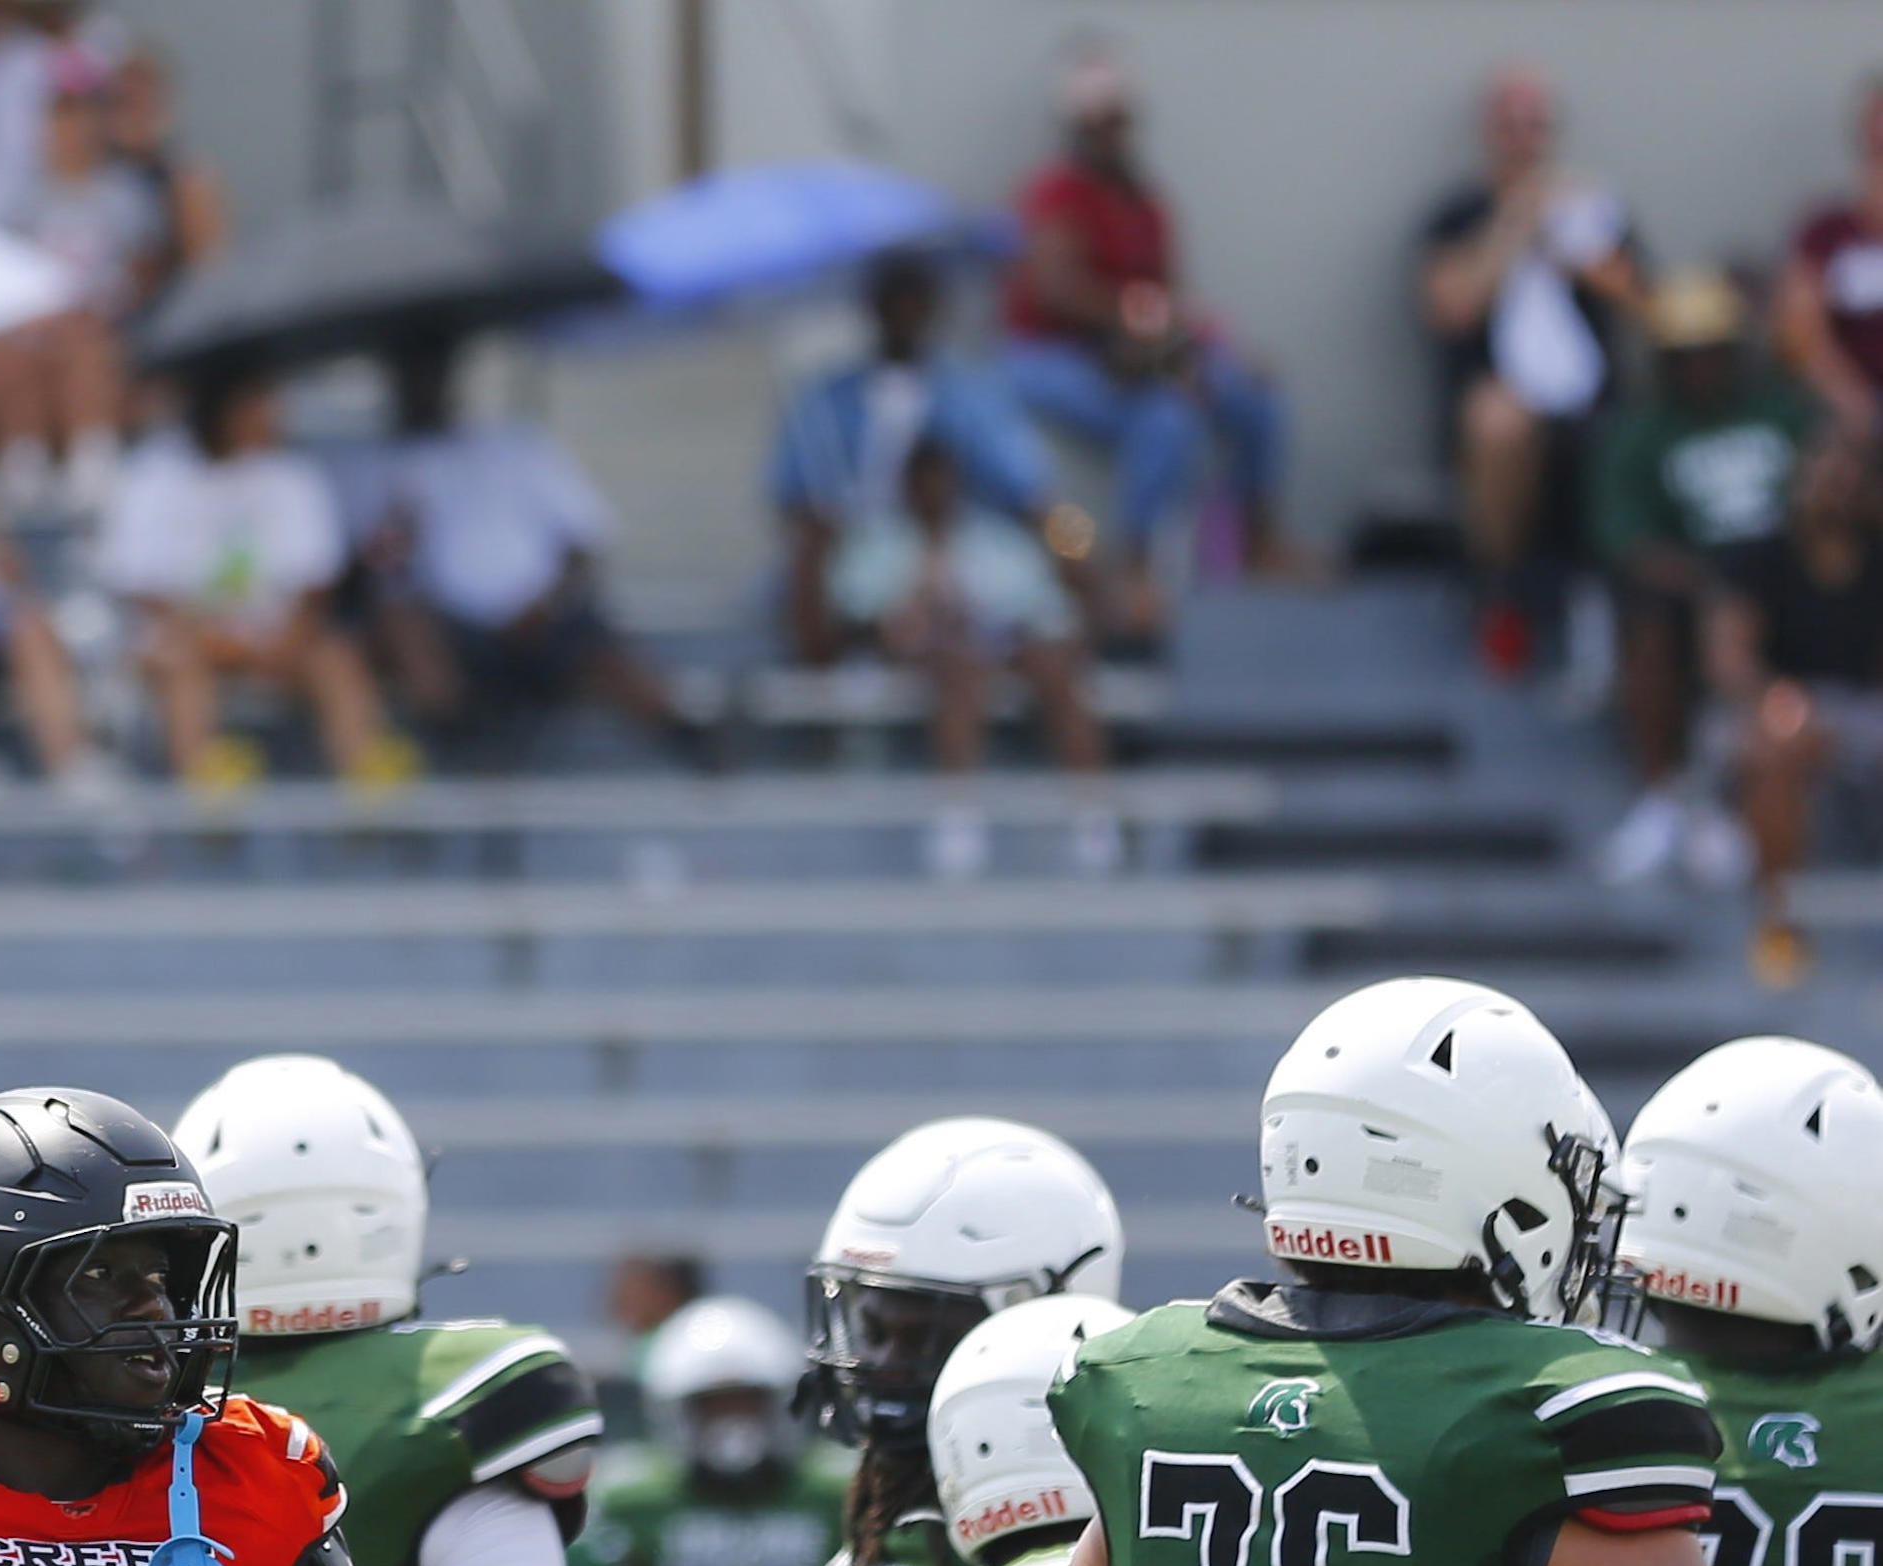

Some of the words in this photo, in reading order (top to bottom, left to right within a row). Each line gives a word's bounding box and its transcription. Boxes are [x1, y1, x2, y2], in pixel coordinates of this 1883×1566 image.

[1270, 1224, 1393, 1264] Riddell
[249, 1300, 381, 1333] Riddell
[957, 1489, 1068, 1542] Riddell
